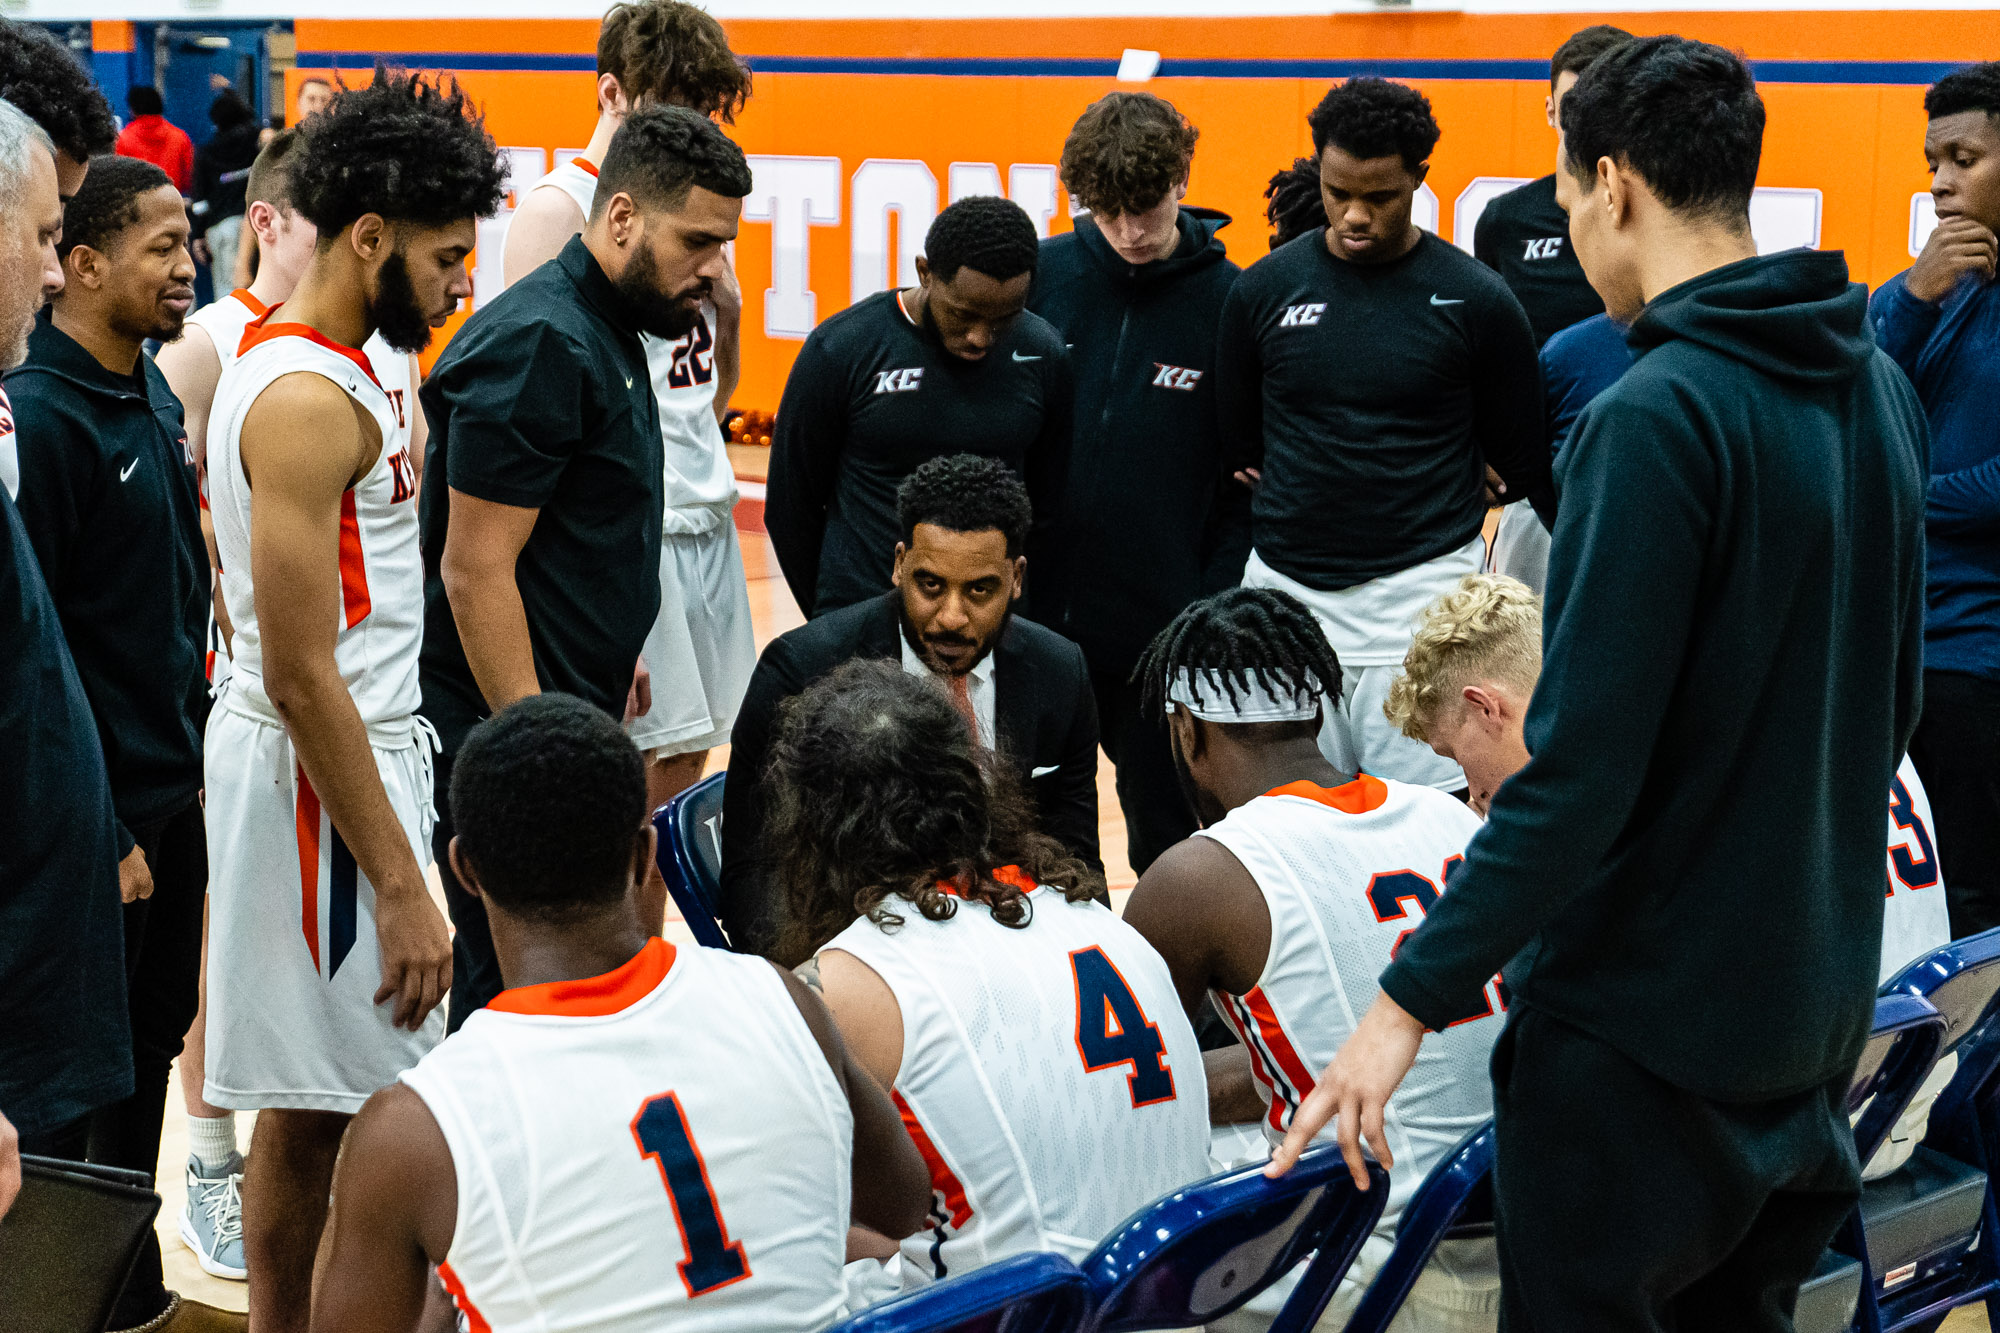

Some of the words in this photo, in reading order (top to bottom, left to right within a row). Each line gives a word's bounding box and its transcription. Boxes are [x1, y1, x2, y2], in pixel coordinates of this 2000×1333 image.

[1522, 237, 1562, 260] KC
[1279, 303, 1327, 327] KC
[874, 368, 924, 394] KC
[1153, 362, 1203, 391] KC
[1885, 770, 1938, 898] 3
[1068, 944, 1176, 1109] 4
[630, 1089, 753, 1299] 1
